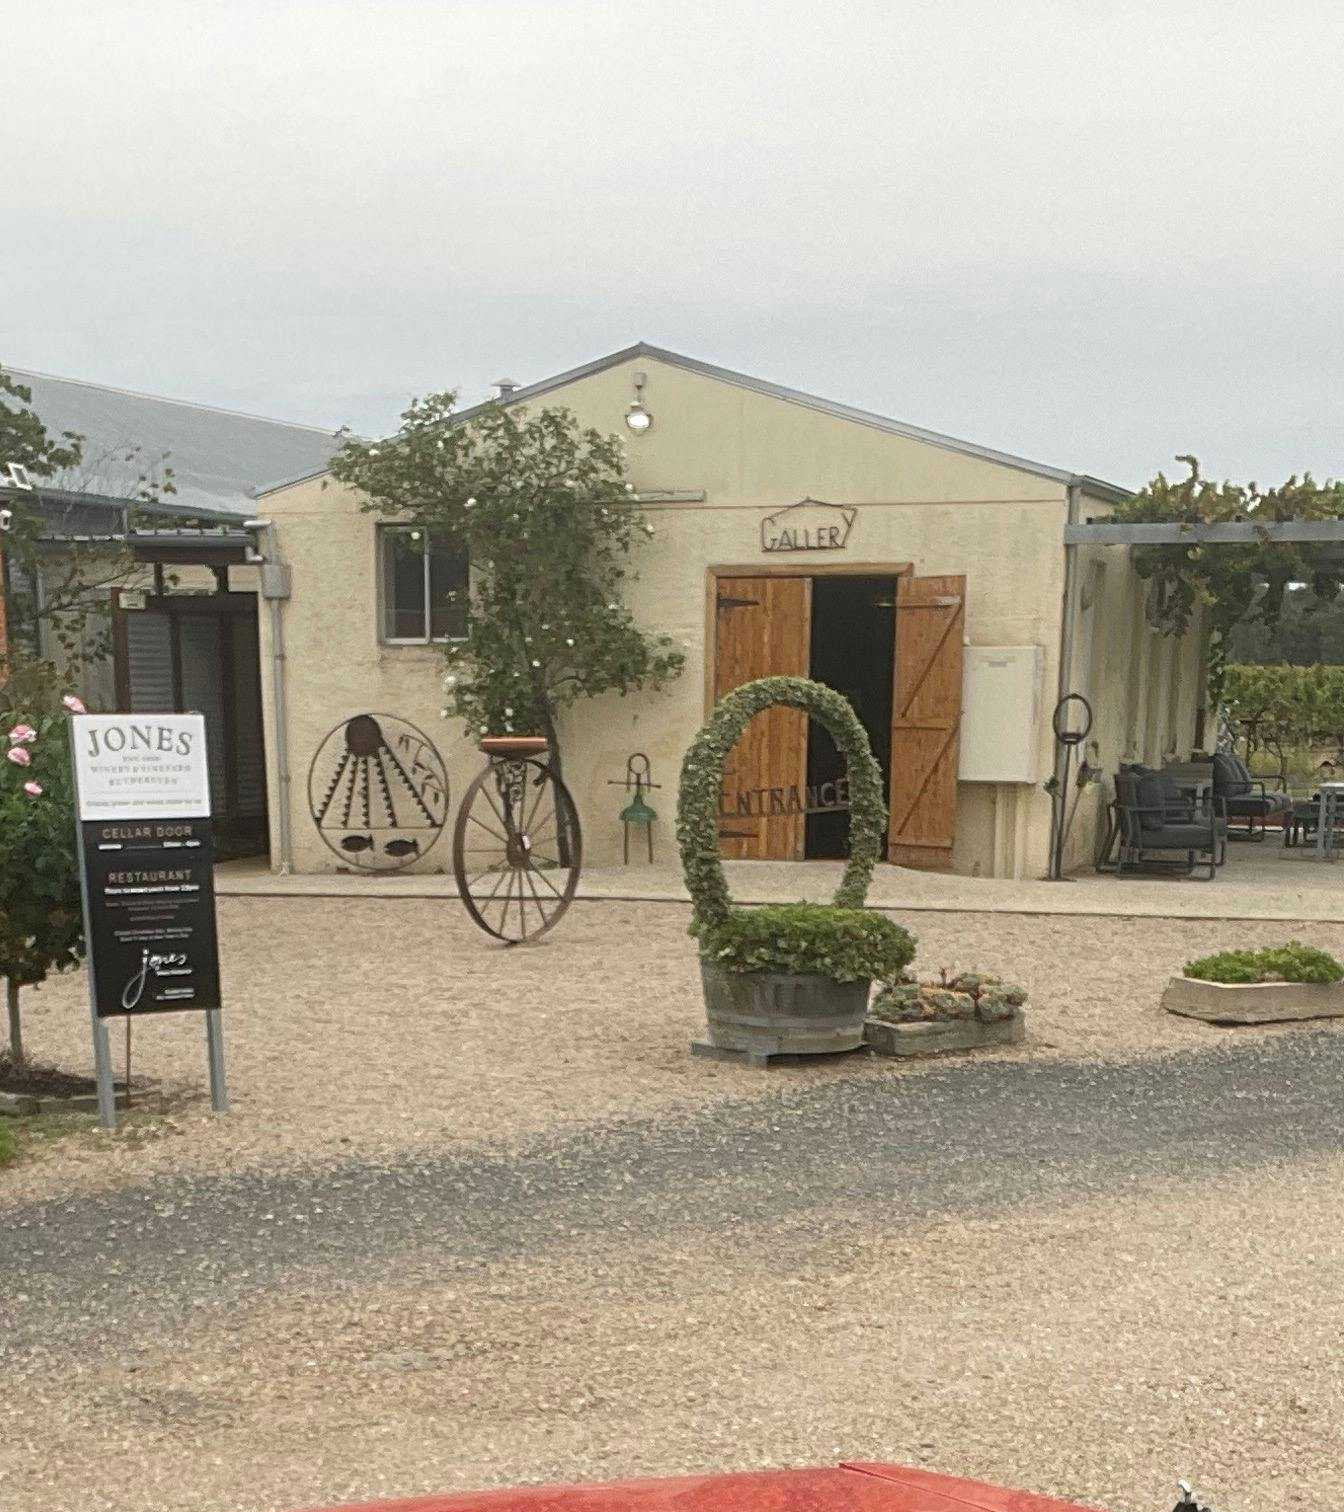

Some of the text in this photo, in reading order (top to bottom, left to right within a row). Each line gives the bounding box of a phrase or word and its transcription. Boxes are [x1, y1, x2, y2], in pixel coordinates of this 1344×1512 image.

[761, 505, 857, 552] GALLERY
[88, 725, 192, 757] JONES
[102, 825, 192, 839] CELLAR DOOR
[108, 869, 192, 883] RESTAURANT
